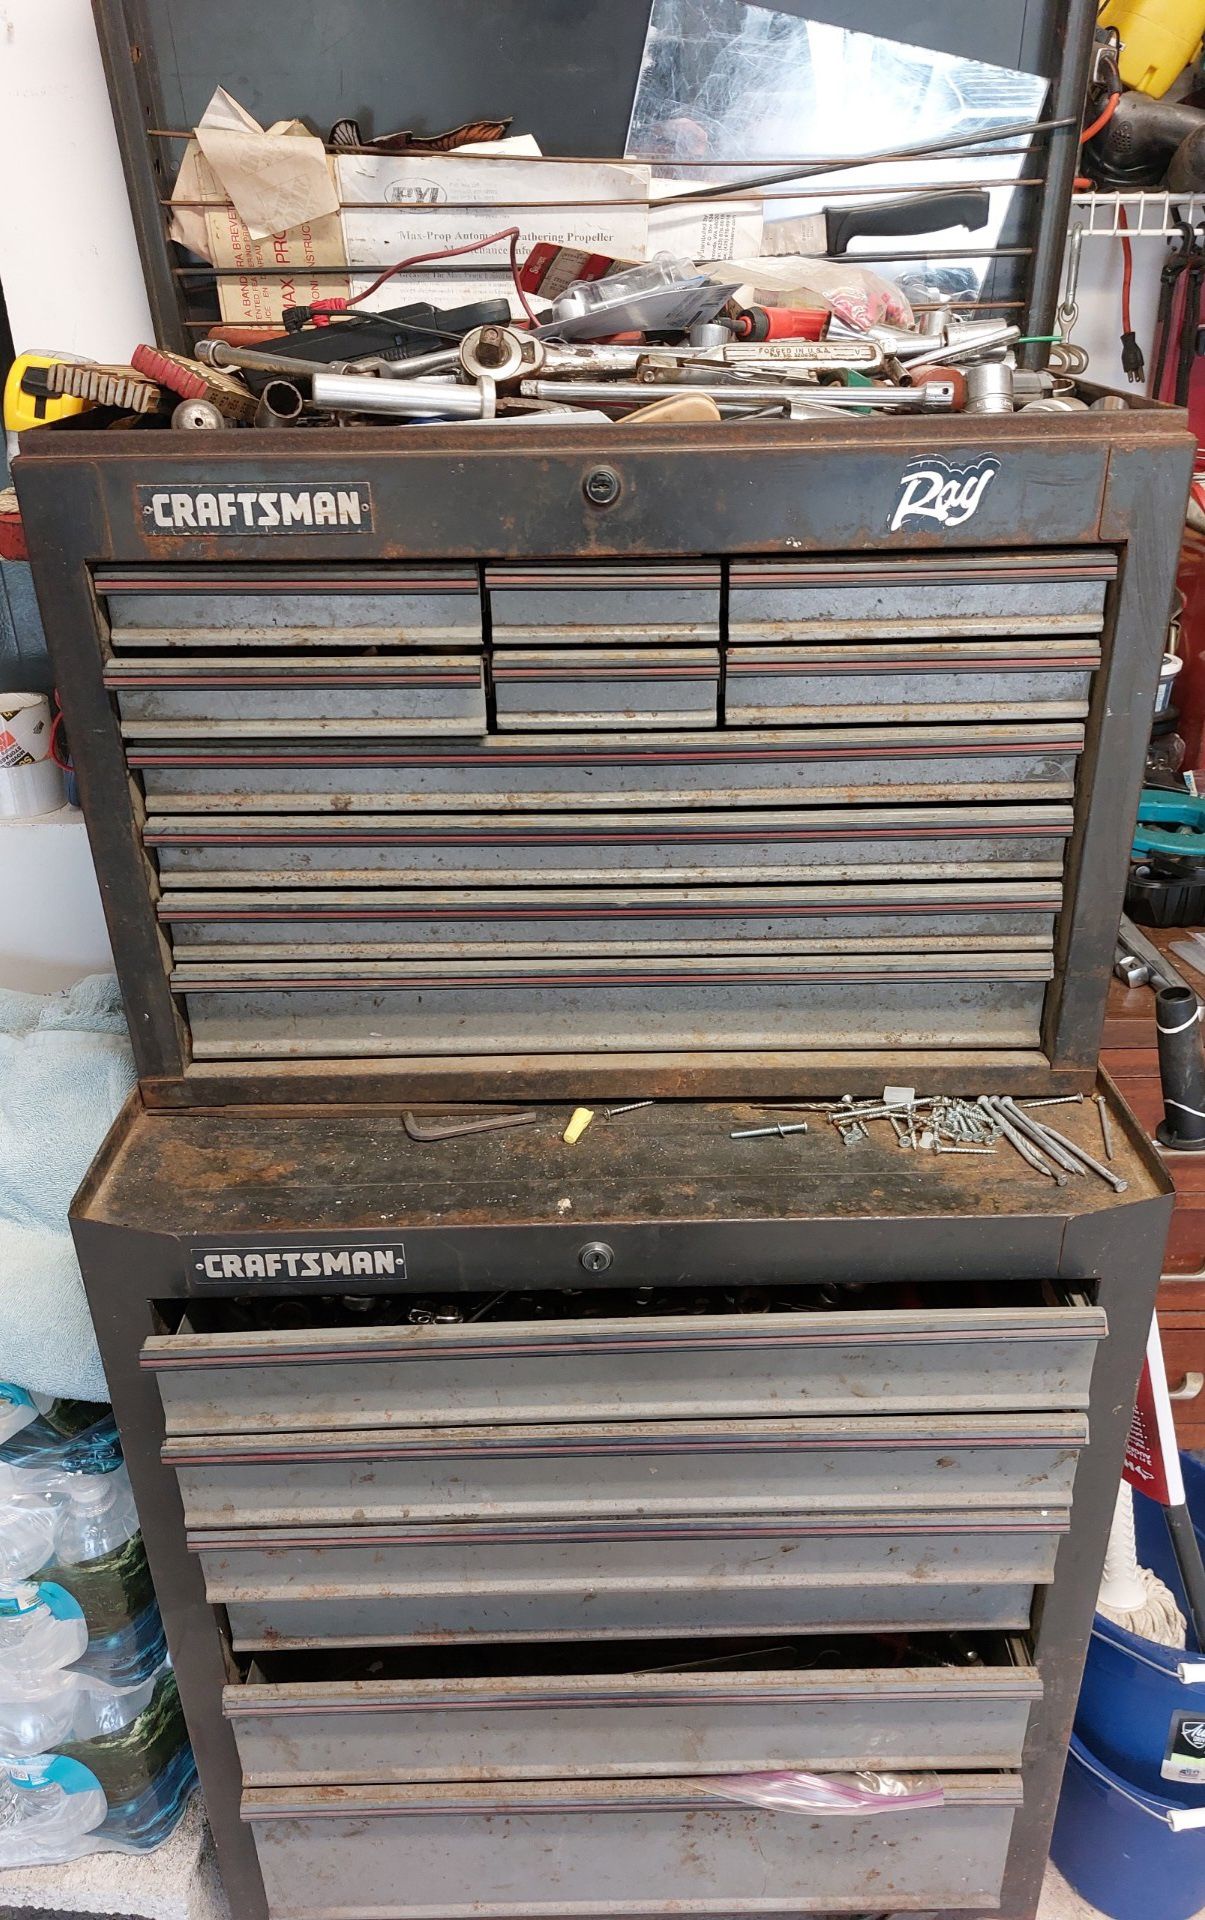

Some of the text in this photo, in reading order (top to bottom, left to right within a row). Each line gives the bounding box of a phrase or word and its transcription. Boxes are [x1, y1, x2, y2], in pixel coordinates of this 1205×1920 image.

[399, 231, 452, 243] Max-Prop
[567, 232, 614, 244] Propeller
[151, 491, 362, 527] CRAFTSMAN
[890, 469, 997, 532] Ray
[203, 1250, 396, 1278] CRAFTSMAN
